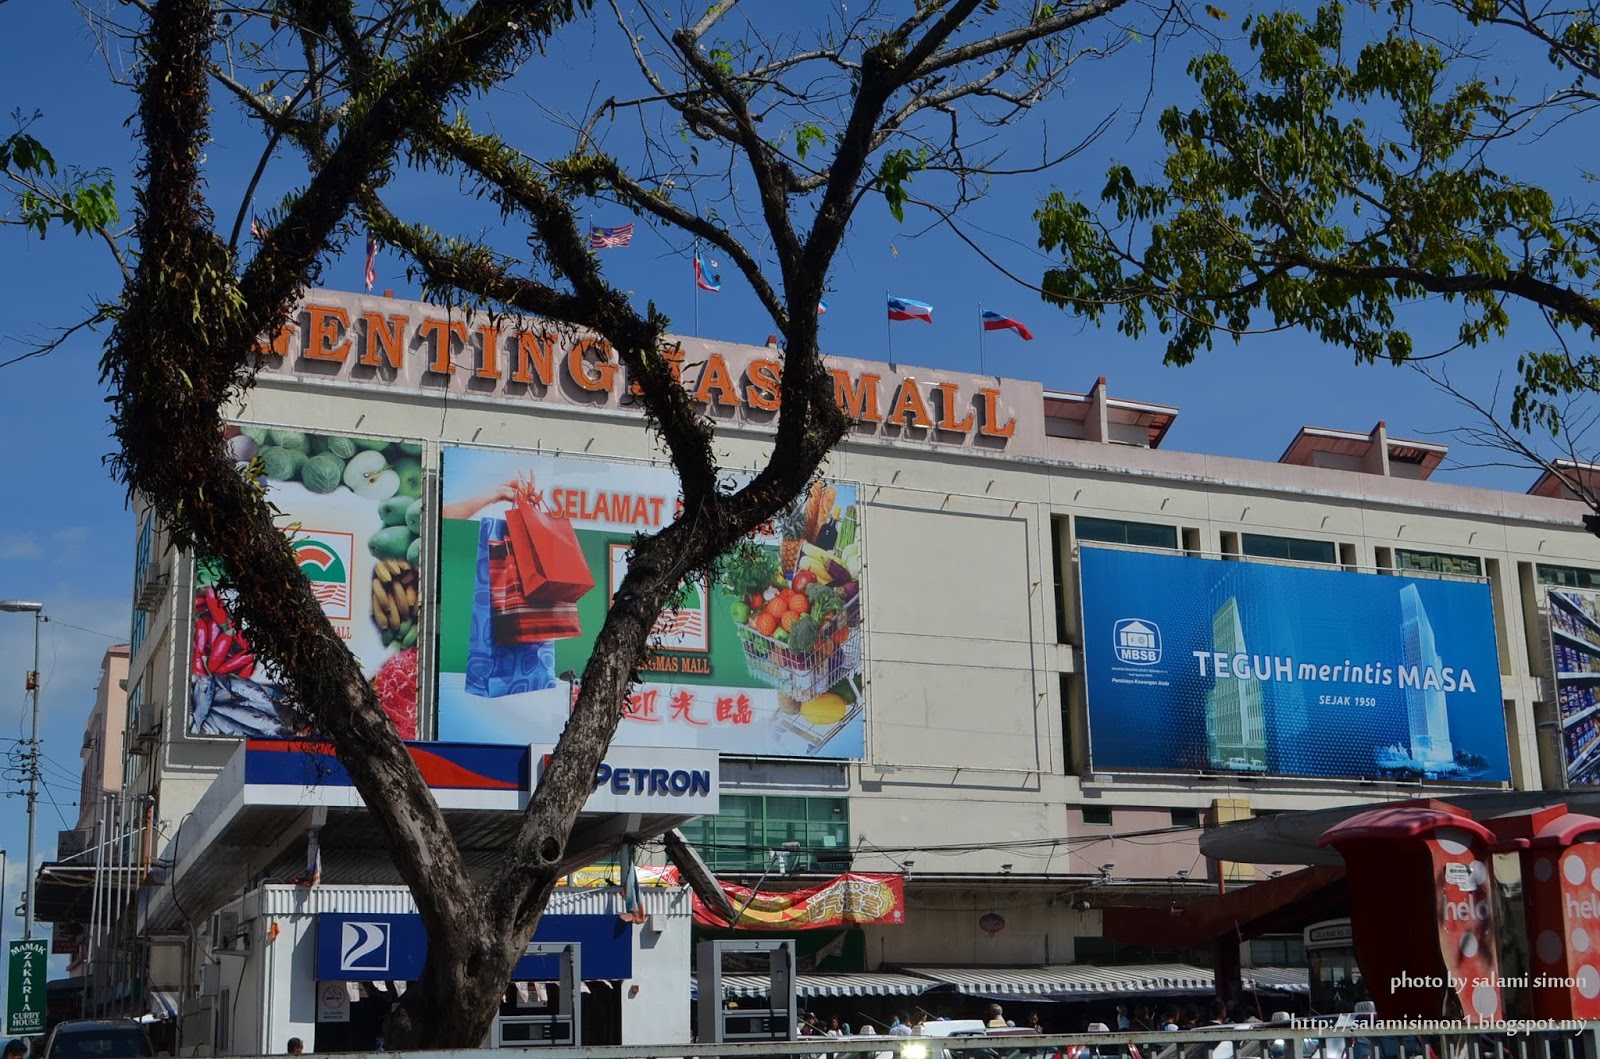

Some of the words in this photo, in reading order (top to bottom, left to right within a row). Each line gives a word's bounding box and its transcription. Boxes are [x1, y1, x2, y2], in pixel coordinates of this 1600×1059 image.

[828, 368, 1016, 438] MALL
[550, 487, 666, 527] SELAMAT
[333, 625, 352, 640] ALL
[681, 657, 710, 674] MALL
[1122, 649, 1156, 661] MBSB
[1192, 650, 1294, 683] TEGUH
[1297, 659, 1394, 686] merintis
[1398, 664, 1477, 694] MASA
[573, 684, 753, 726] 迎光臨
[1318, 695, 1351, 706] SEJAK
[1354, 697, 1376, 707] 1950
[595, 763, 711, 793] PETRON
[1442, 893, 1490, 921] helo
[1565, 893, 1600, 919] hel
[10, 943, 46, 956] MAMAK
[537, 944, 543, 952] 4
[755, 941, 760, 949] 2
[22, 952, 32, 1011] ZAKARIA
[12, 1012, 40, 1020] CURRY
